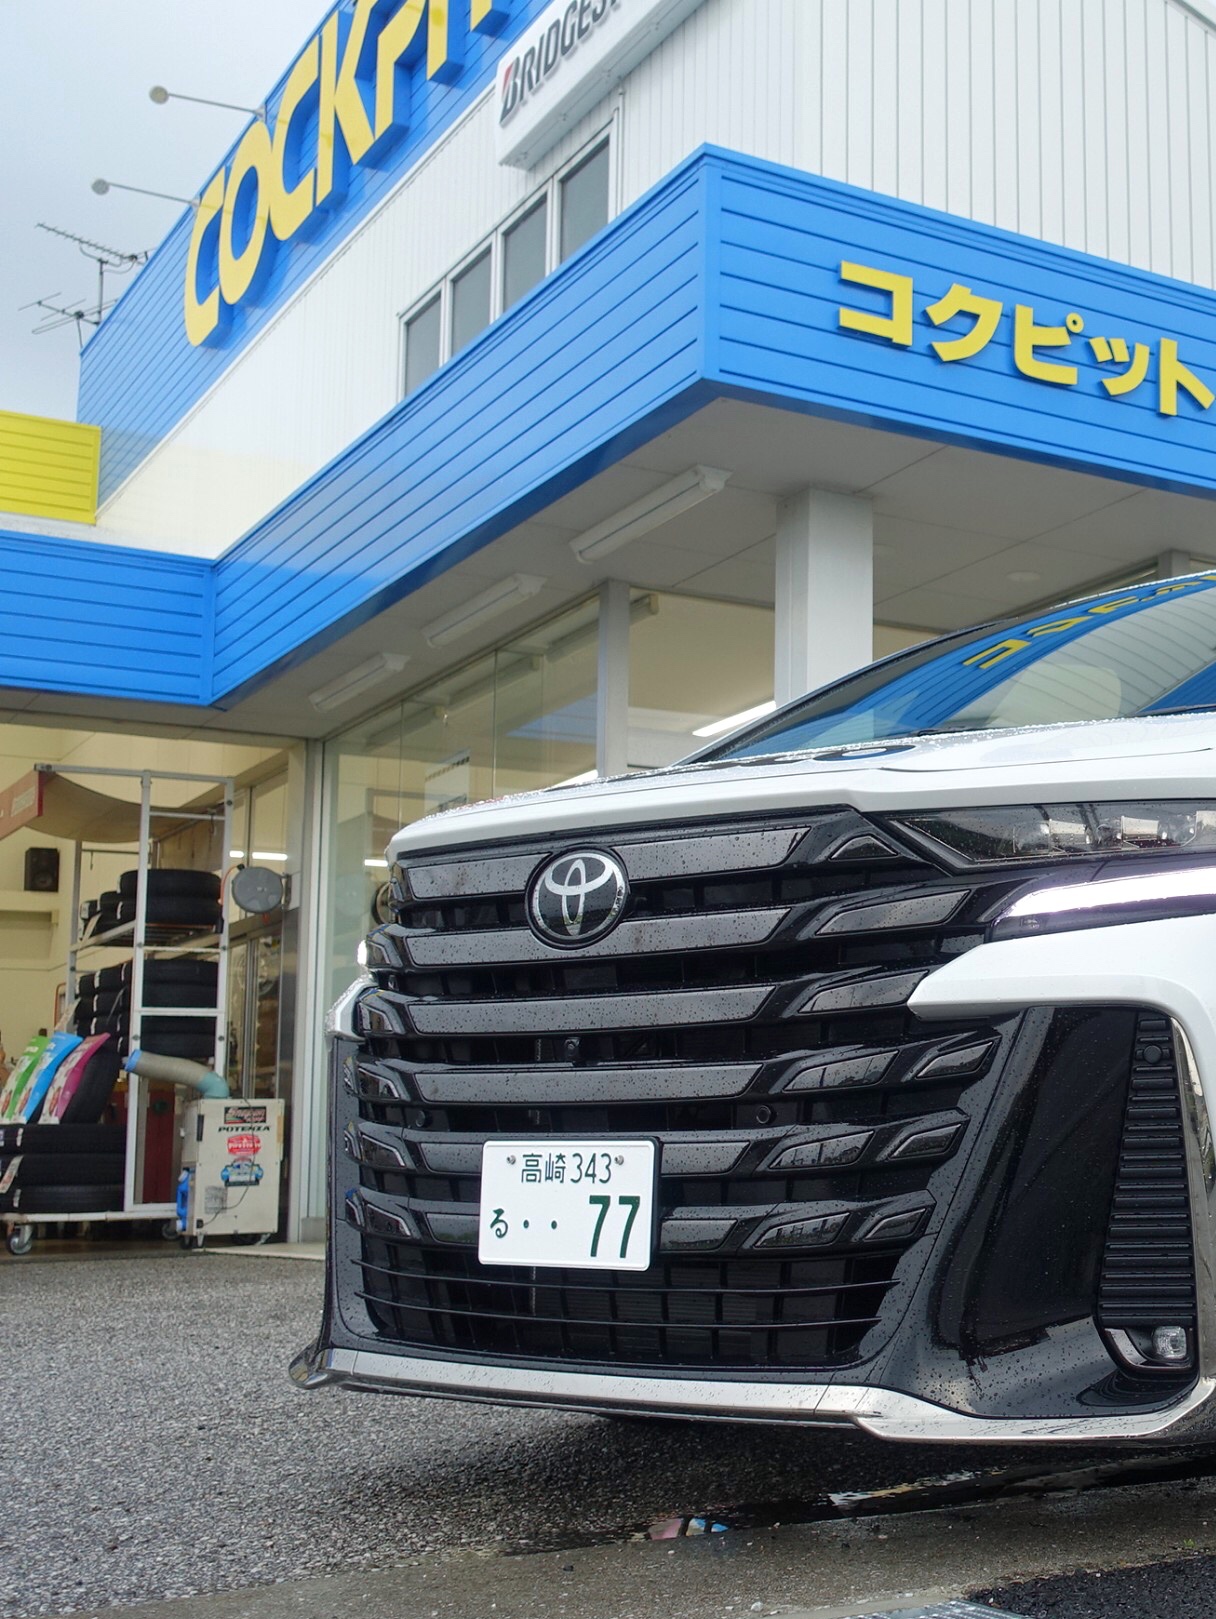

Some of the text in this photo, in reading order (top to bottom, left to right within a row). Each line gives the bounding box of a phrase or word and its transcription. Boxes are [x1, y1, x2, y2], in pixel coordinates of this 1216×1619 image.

[499, 0, 617, 123] BRIDGE
[185, 0, 491, 346] COCKP
[839, 260, 1215, 416] コクピット
[520, 1152, 612, 1184] 高崎343
